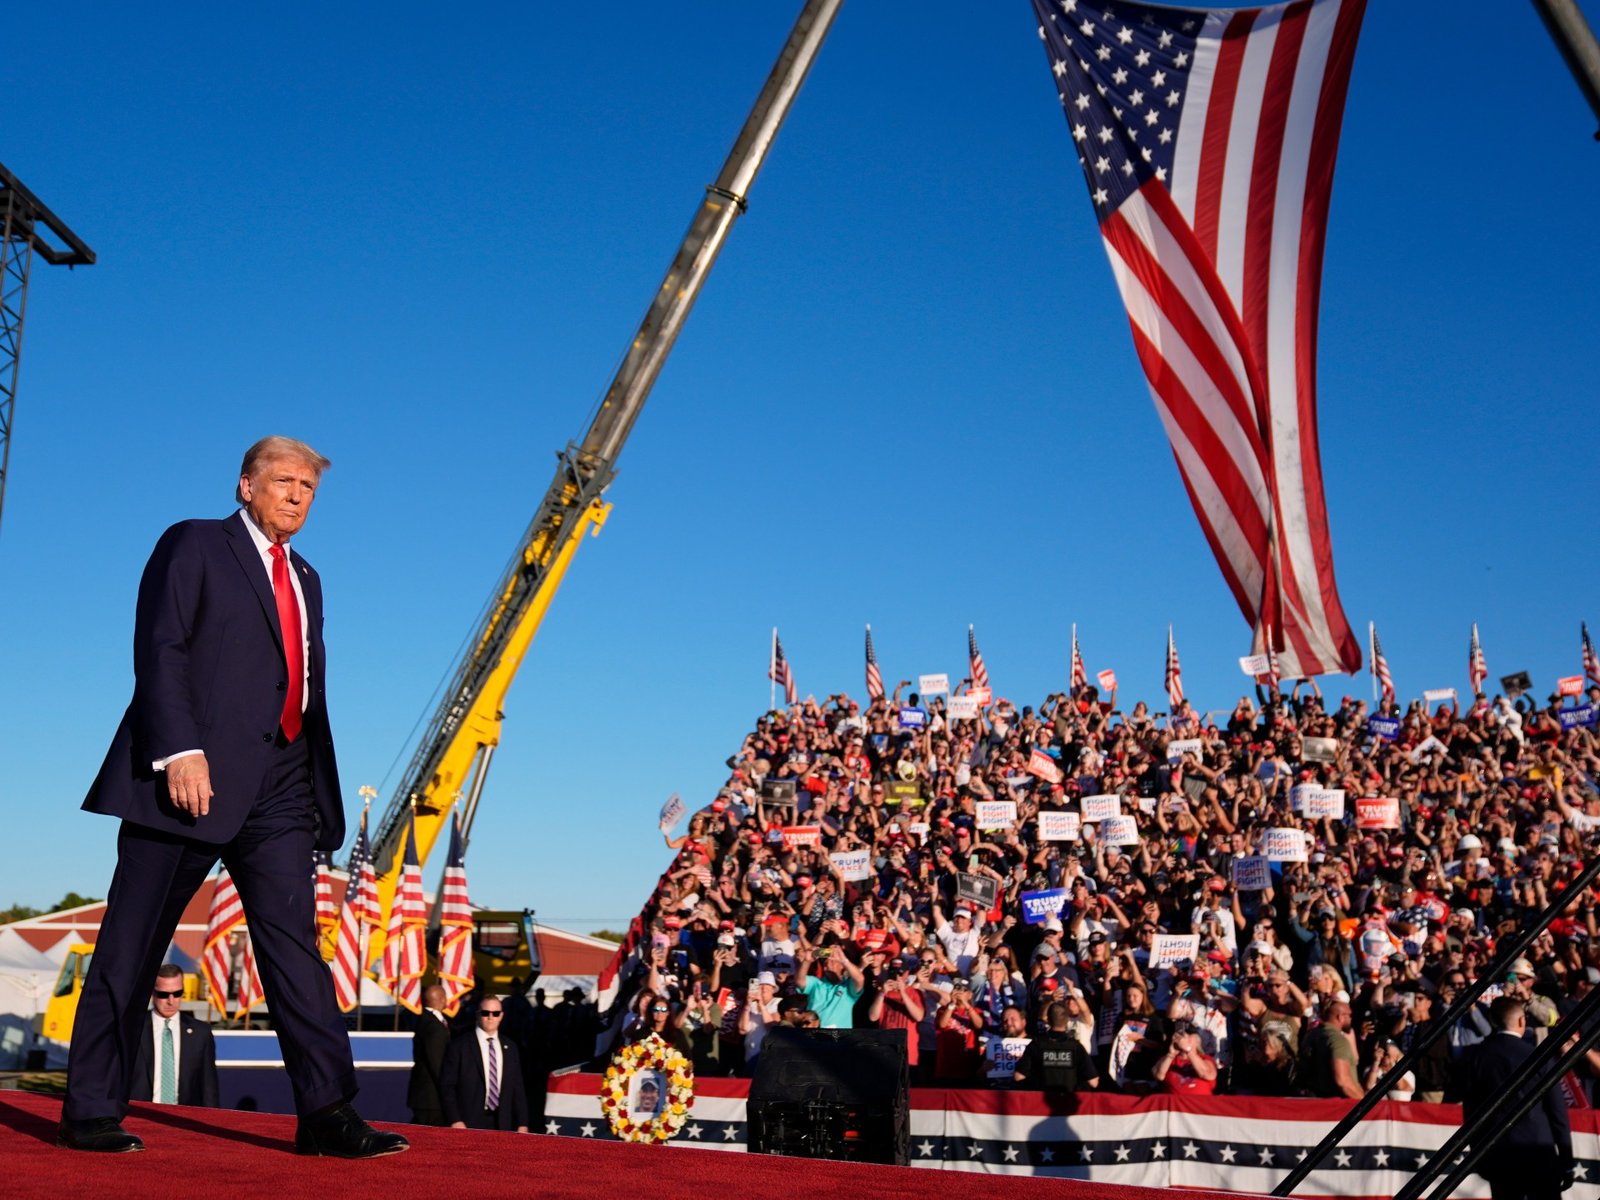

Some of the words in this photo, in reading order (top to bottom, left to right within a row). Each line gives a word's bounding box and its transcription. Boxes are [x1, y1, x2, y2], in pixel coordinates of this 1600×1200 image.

[1237, 860, 1263, 868] FIGHT!
[1237, 868, 1264, 876] FIGHT!
[1043, 1052, 1071, 1061] POLICE
